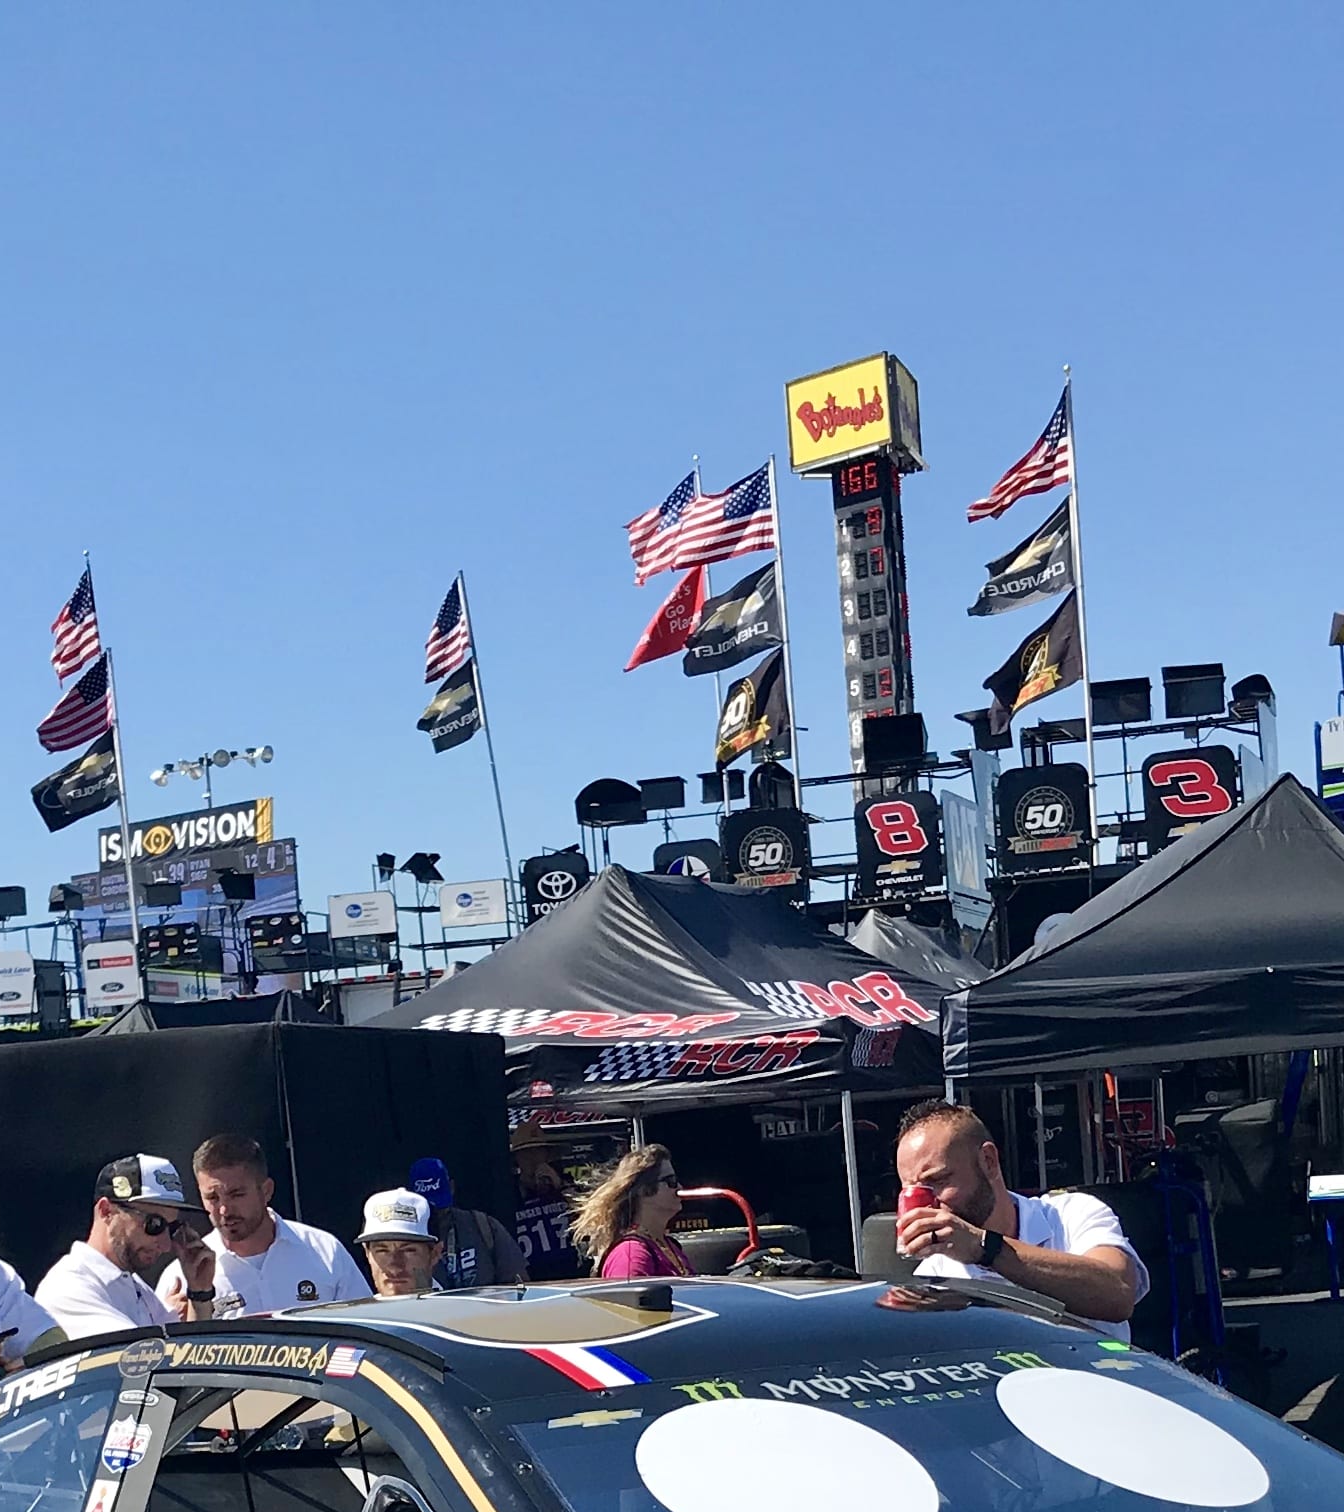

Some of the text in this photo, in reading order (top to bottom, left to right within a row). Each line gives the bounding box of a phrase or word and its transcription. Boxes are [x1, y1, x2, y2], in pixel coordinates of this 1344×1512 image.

[841, 561, 850, 576] 2
[665, 604, 685, 619] Go
[844, 600, 854, 616] 3
[846, 640, 857, 656] 4
[850, 680, 860, 696] 5
[851, 719, 861, 736] 6
[1327, 720, 1341, 733] TY
[853, 759, 864, 774] 7
[1148, 759, 1232, 817] 3
[1024, 804, 1064, 829] 50
[100, 809, 256, 862] ISM VISION
[864, 800, 929, 857] 8
[266, 847, 276, 870] 4
[748, 842, 785, 867] 50
[875, 874, 924, 887] CHEVROLET
[796, 971, 940, 1027] RCR
[667, 1029, 821, 1077] RCR
[112, 1176, 133, 1198] 3
[414, 1178, 441, 1193] Ford
[182, 1342, 313, 1369] AUSTINDILLON3
[852, 1388, 982, 1408] ENERGY
